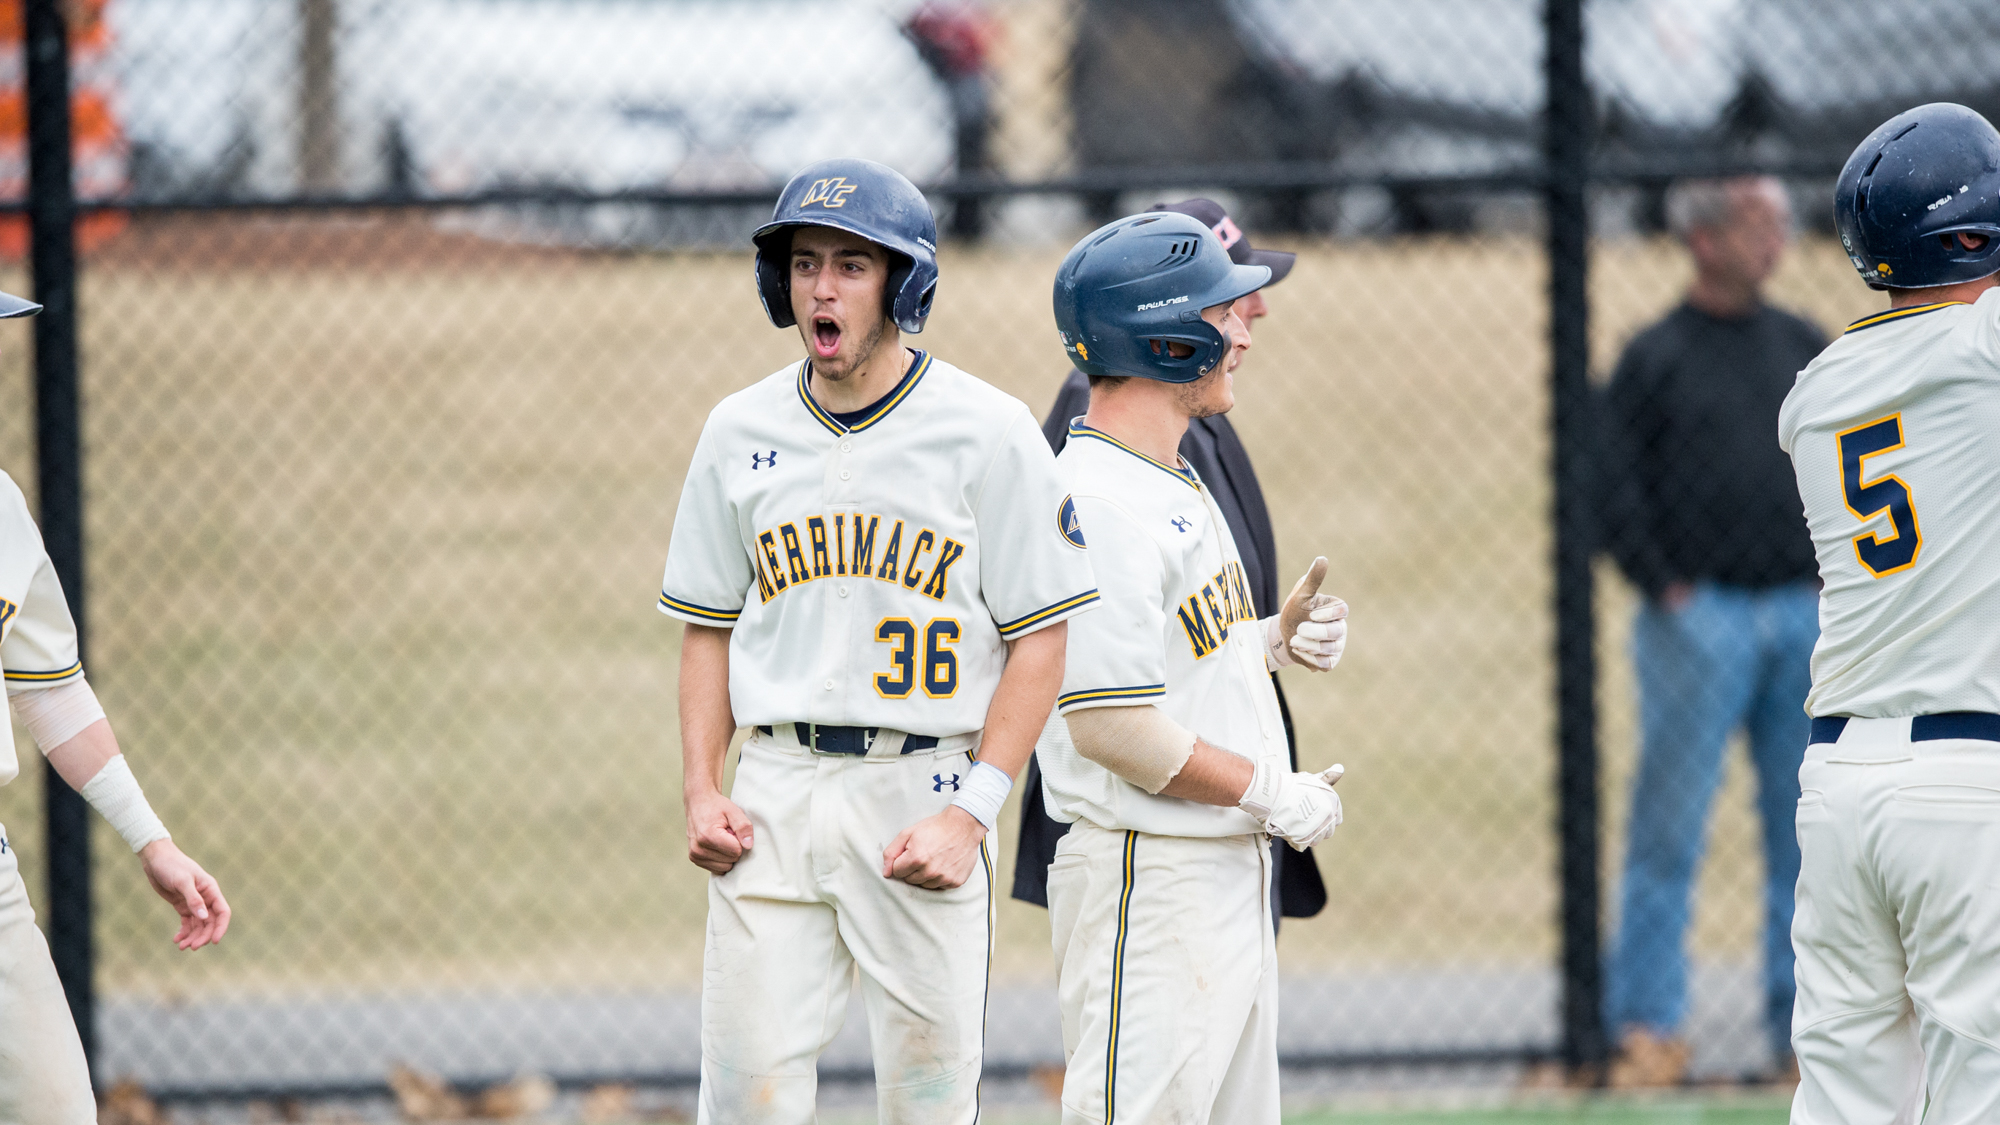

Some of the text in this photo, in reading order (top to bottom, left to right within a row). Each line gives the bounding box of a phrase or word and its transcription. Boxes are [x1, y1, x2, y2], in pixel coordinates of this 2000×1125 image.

[1137, 295, 1190, 312] RAWLINGS
[1835, 411, 1923, 580] 5
[754, 513, 966, 606] MERRIMACK
[873, 617, 963, 699] 36
